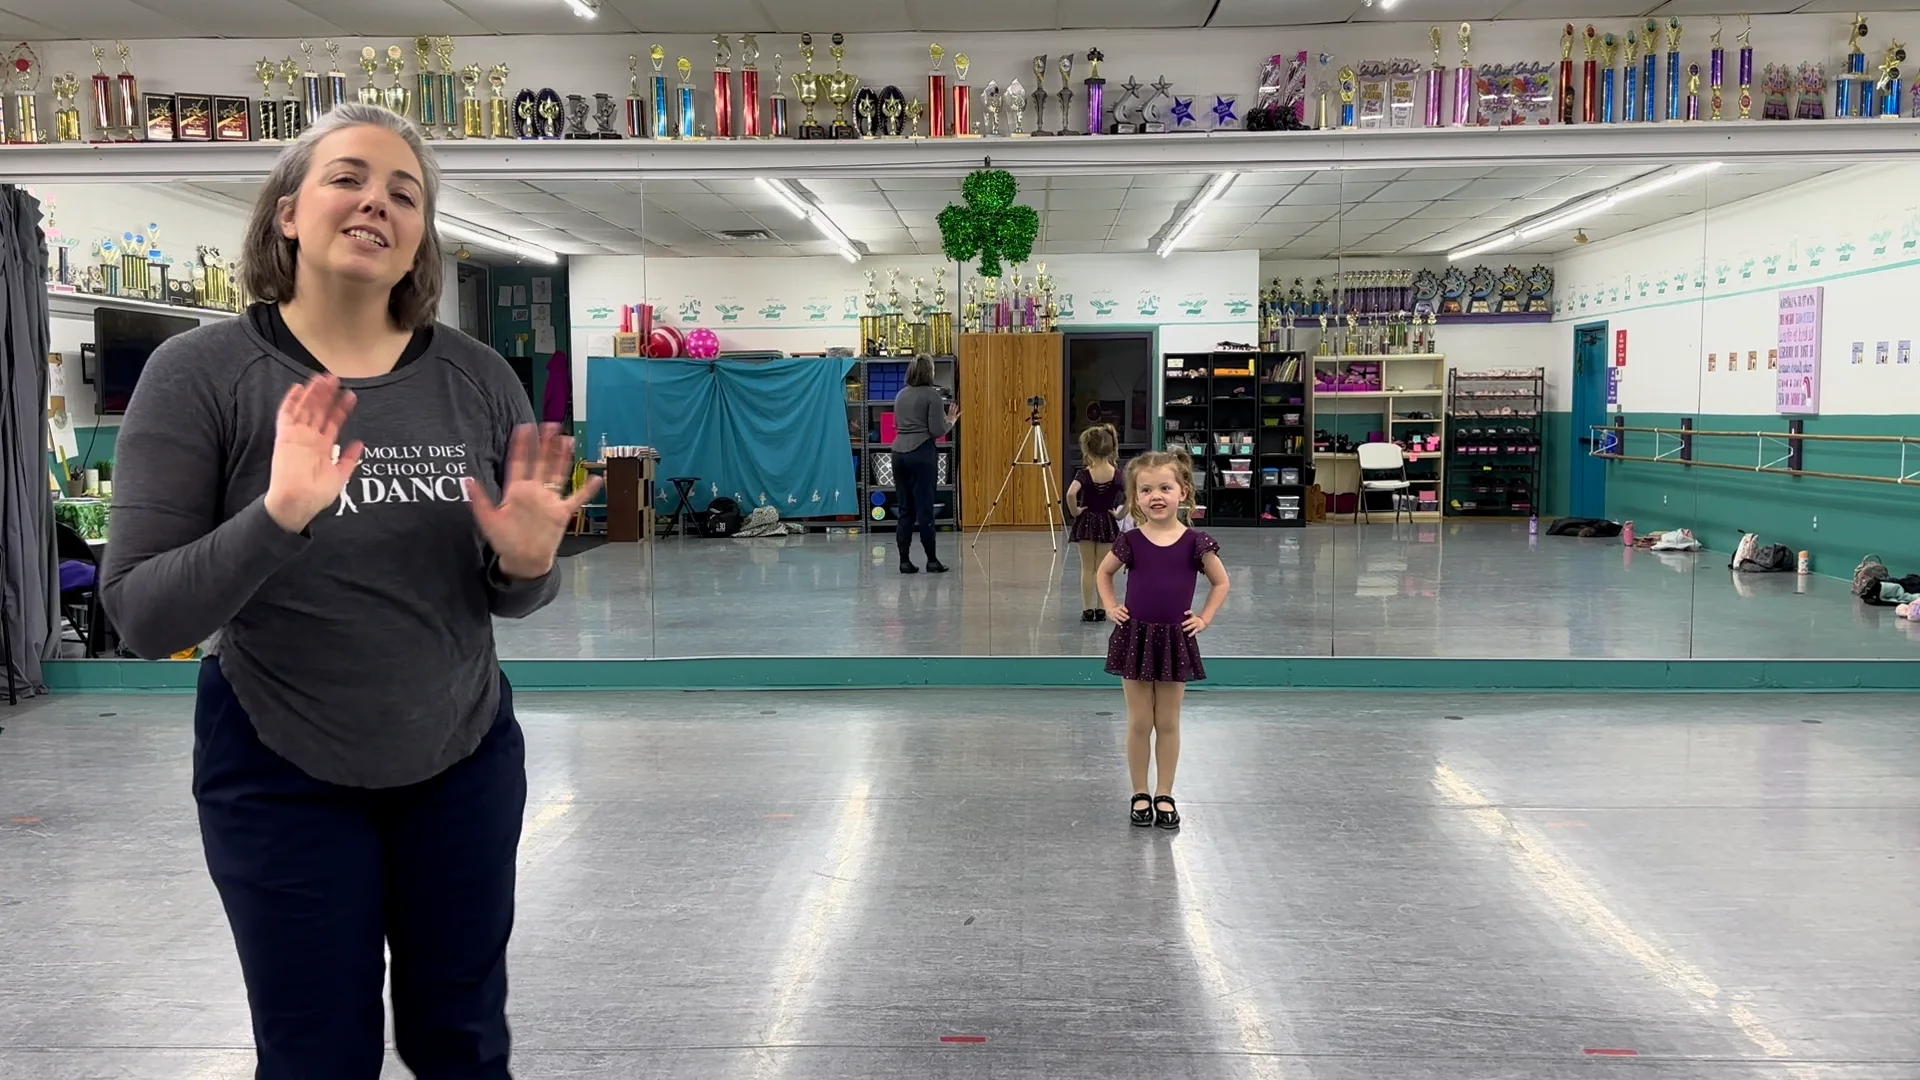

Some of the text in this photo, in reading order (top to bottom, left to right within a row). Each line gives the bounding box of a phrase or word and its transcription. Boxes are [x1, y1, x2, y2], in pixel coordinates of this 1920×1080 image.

[364, 443, 466, 459] MOLLY DIES'
[361, 462, 467, 476] SCHOOL OF
